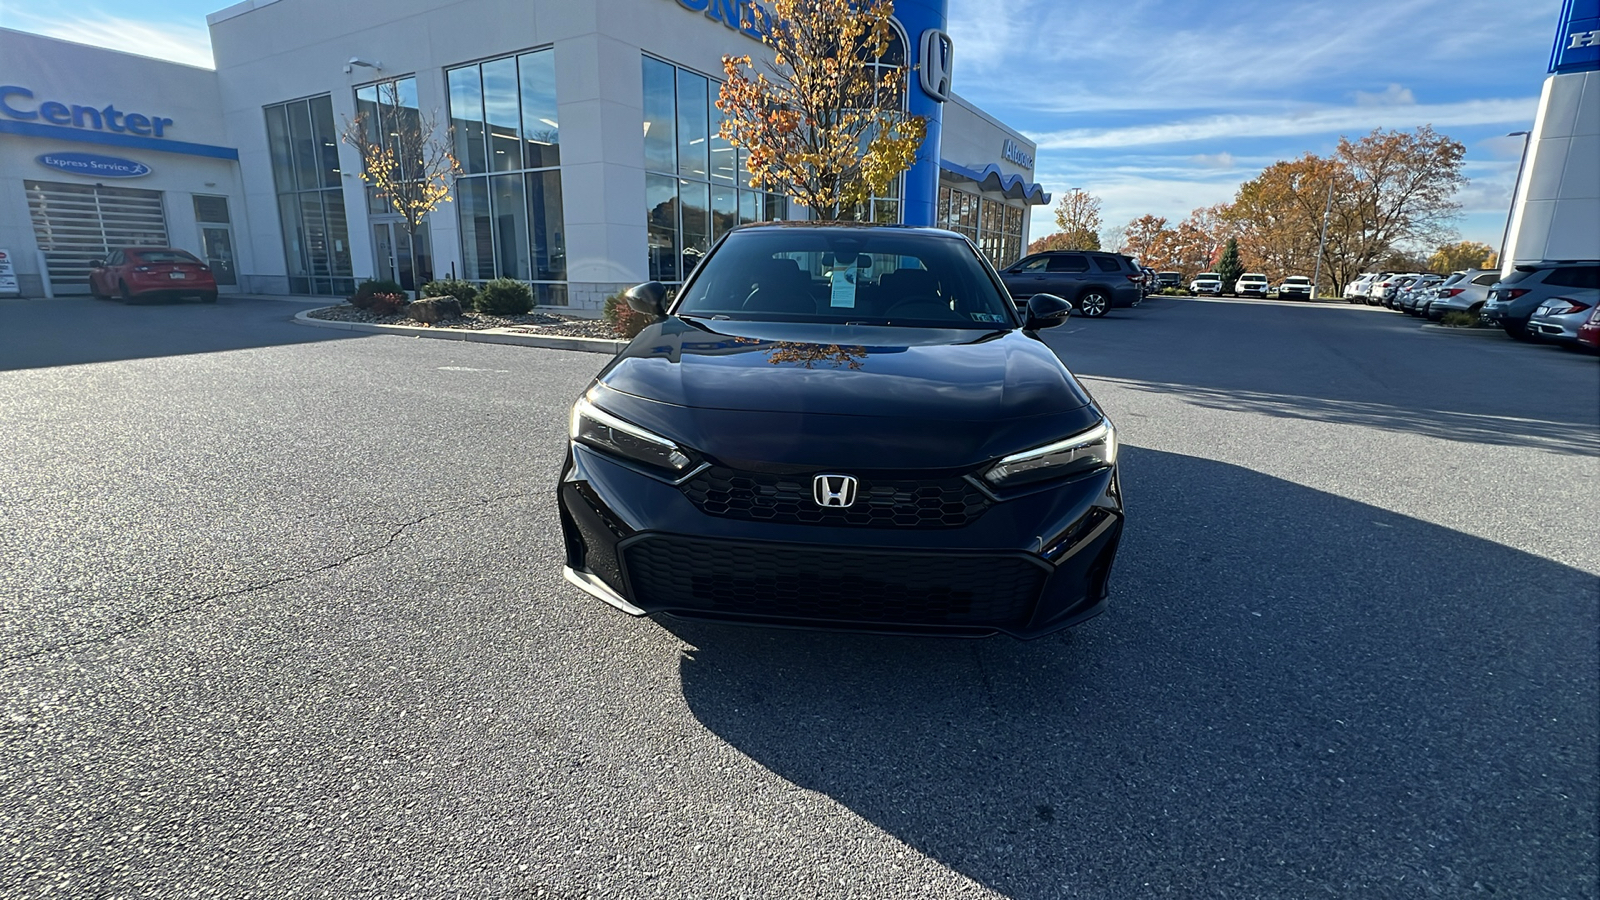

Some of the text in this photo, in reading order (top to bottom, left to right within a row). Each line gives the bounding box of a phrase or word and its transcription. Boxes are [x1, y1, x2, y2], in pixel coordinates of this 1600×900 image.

[0, 85, 173, 138] Center
[45, 156, 129, 172] Express Service
